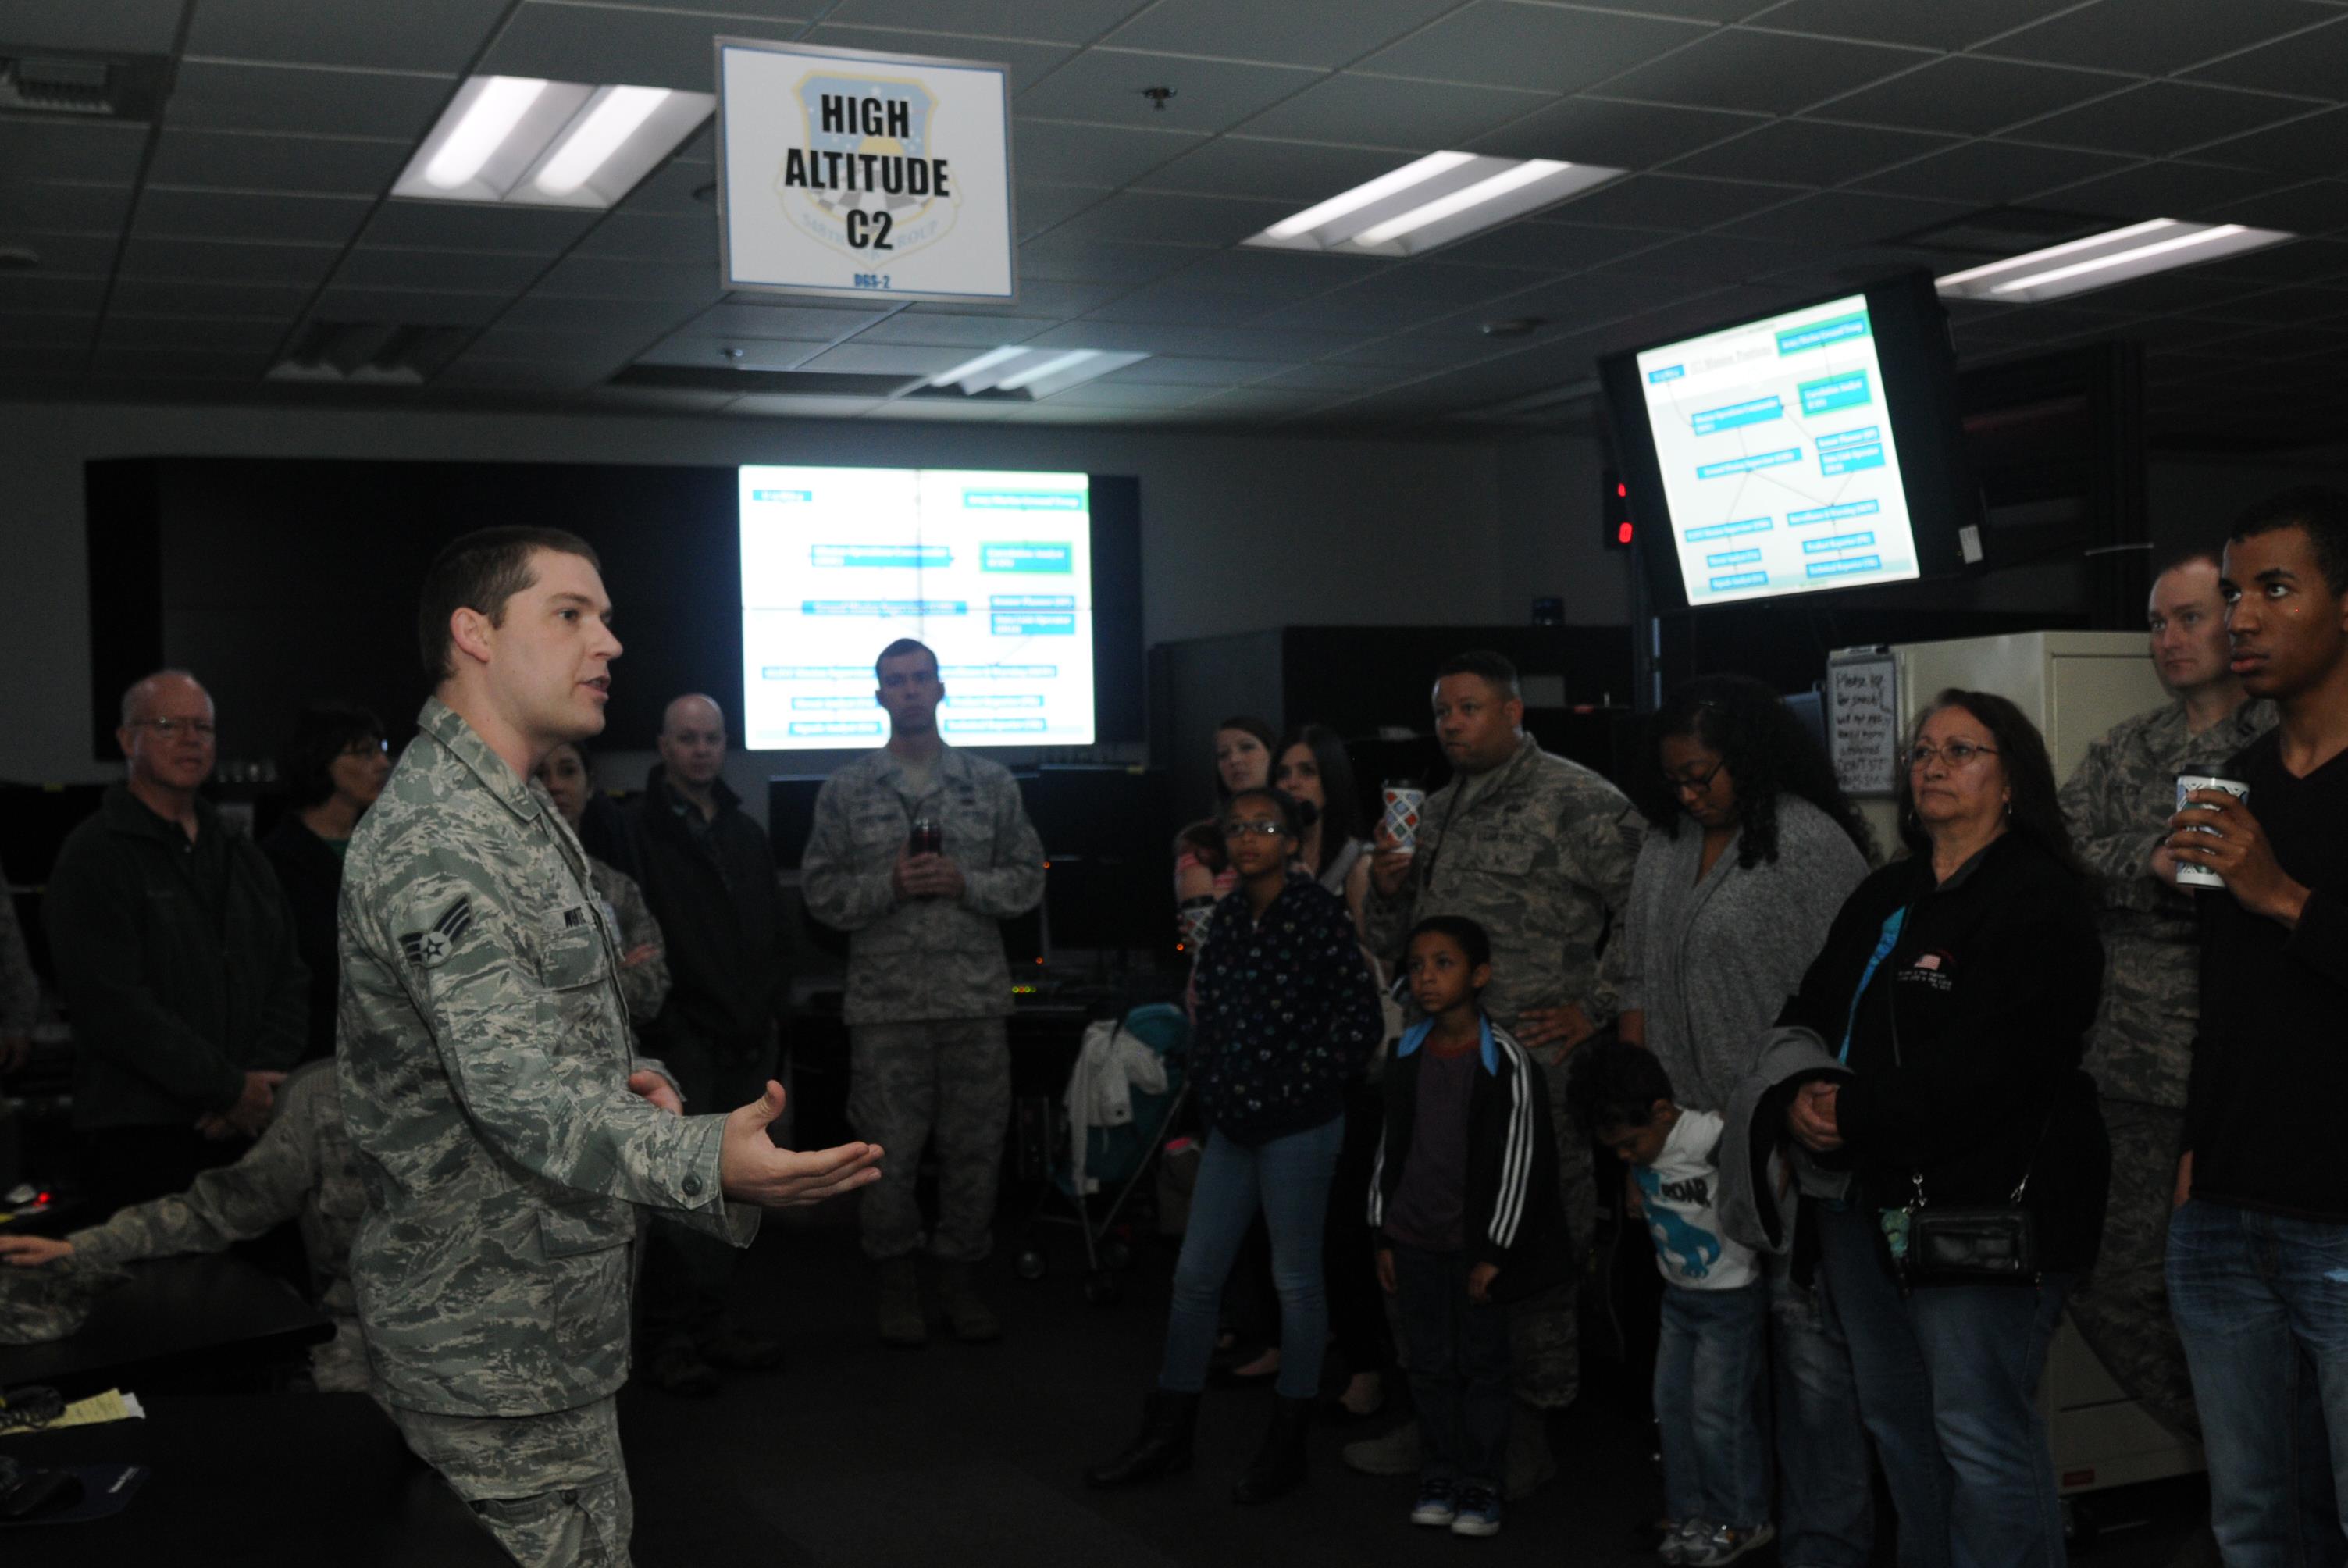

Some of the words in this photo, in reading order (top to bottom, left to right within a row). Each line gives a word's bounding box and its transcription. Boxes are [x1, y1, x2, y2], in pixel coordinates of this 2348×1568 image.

[821, 94, 909, 138] HIGH
[785, 148, 950, 197] ALTITUDE
[846, 208, 894, 250] C2
[854, 273, 891, 289] DGS-2
